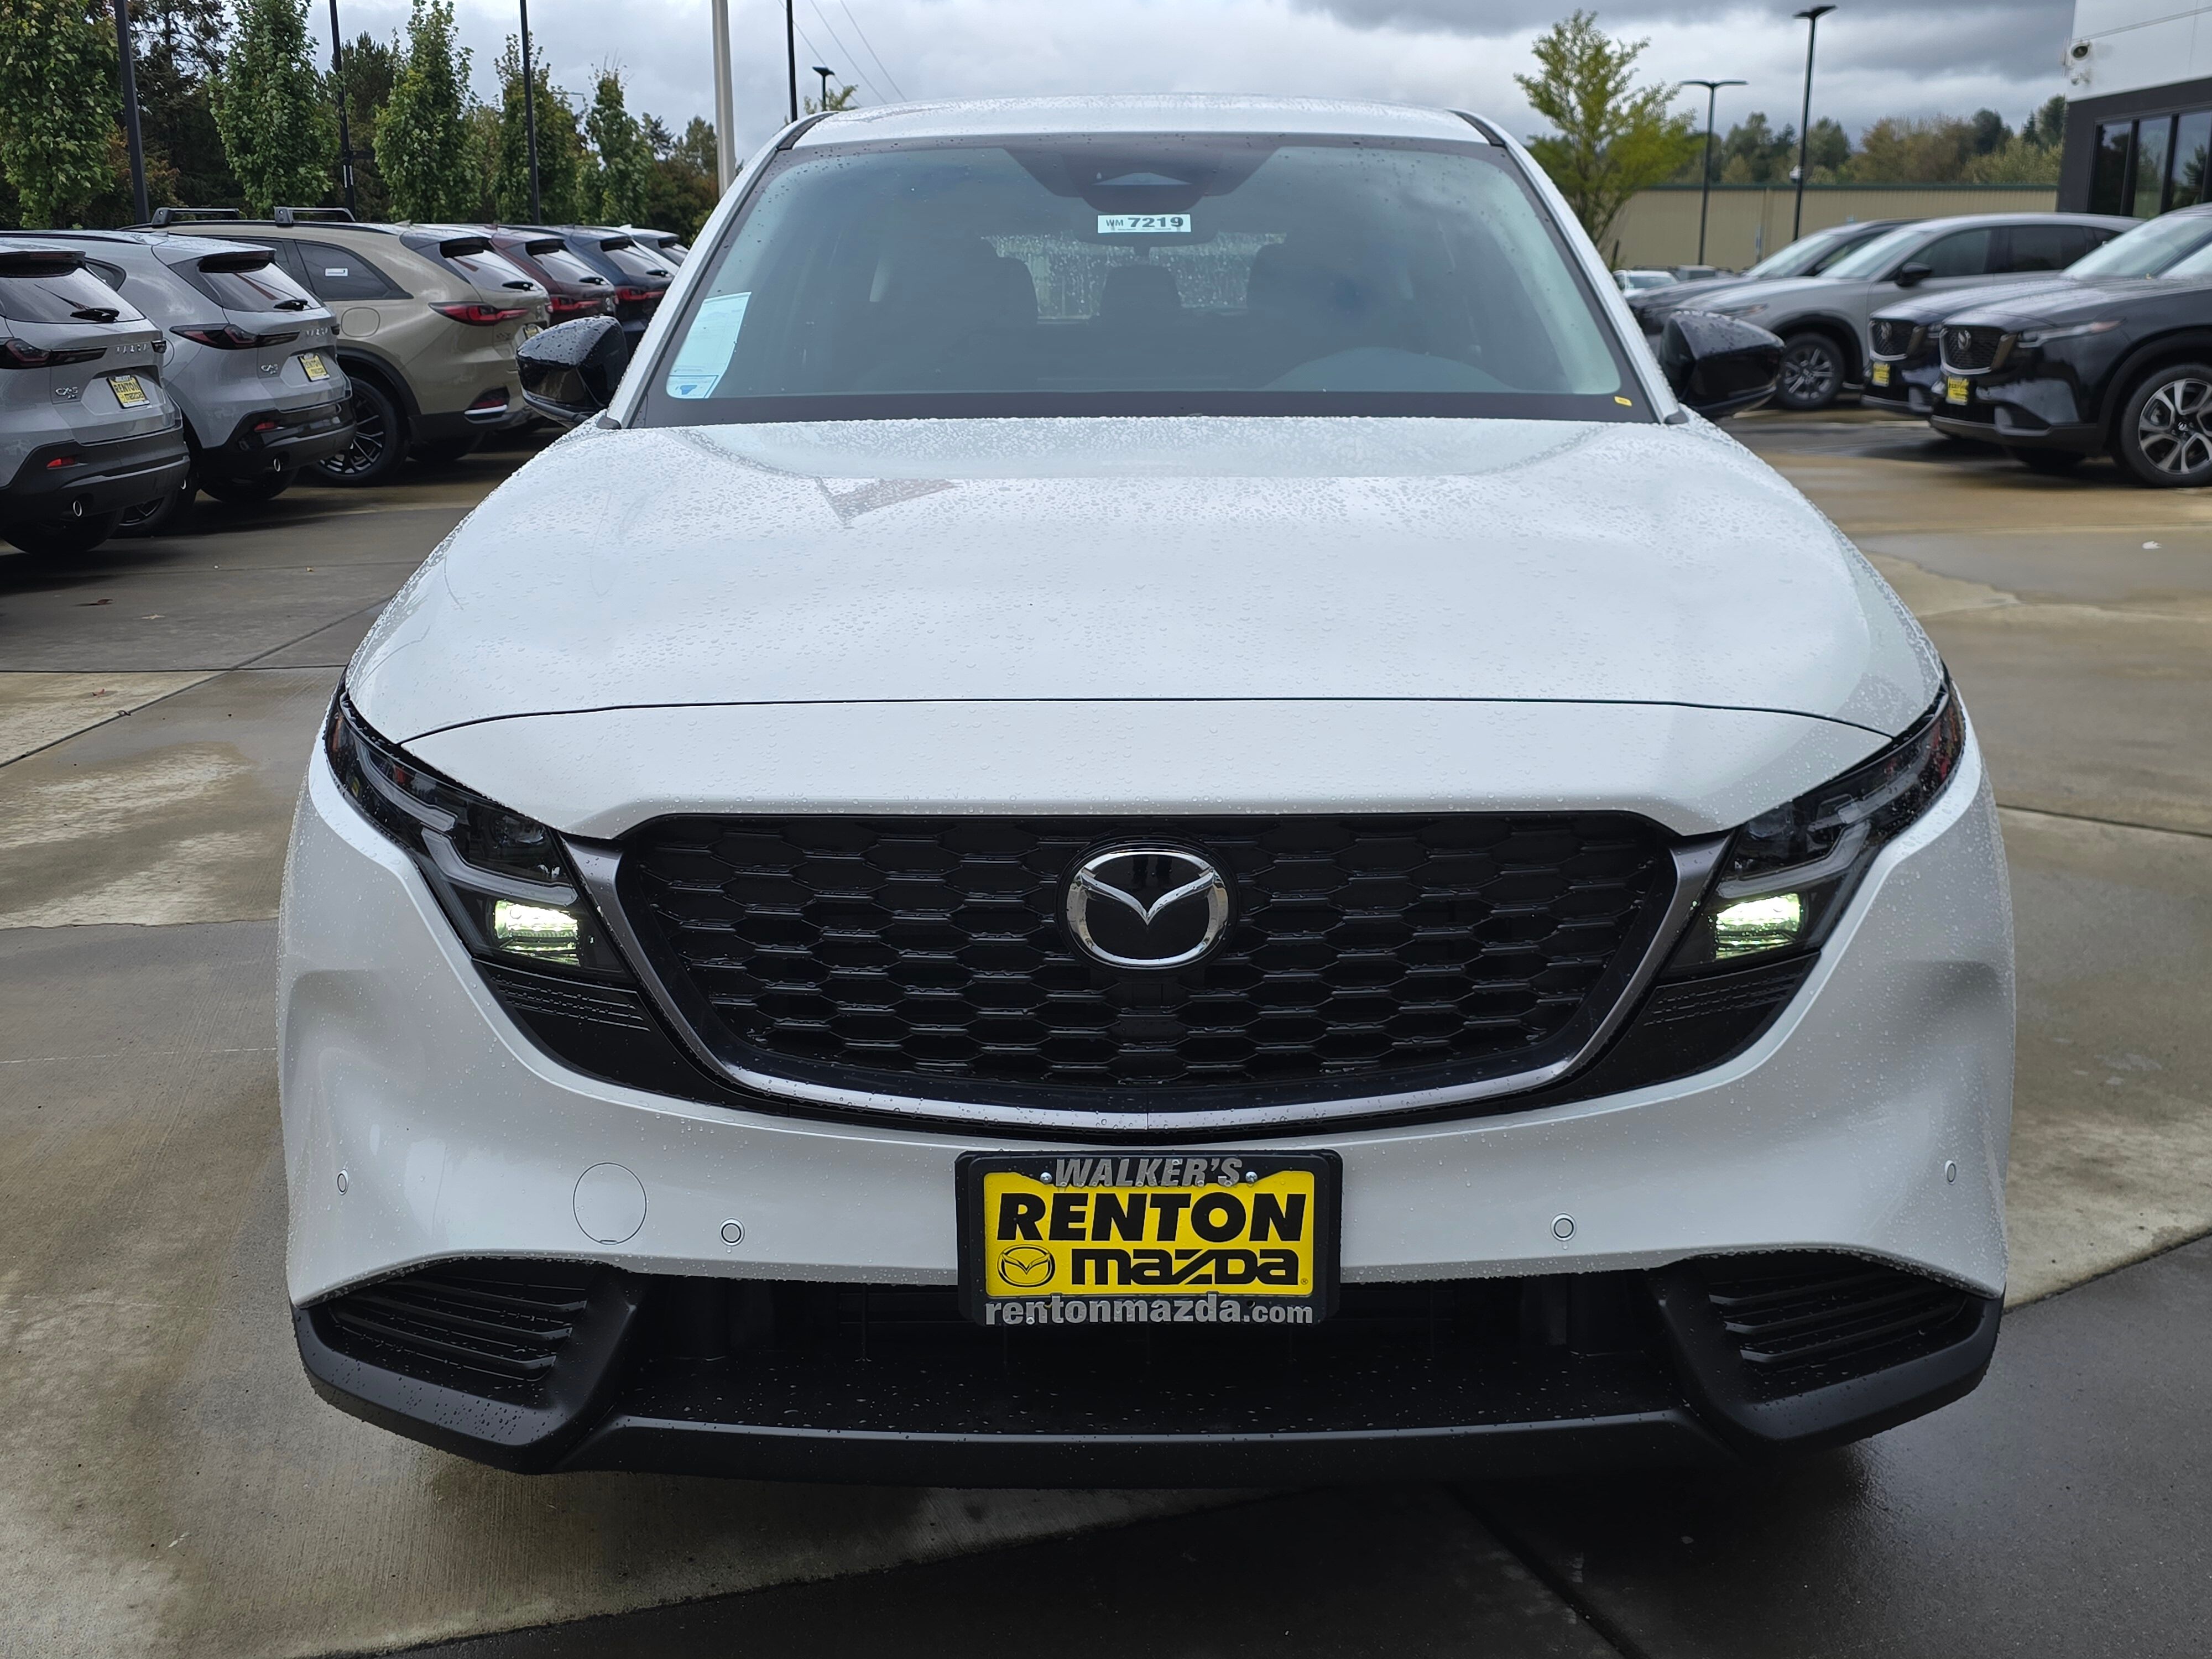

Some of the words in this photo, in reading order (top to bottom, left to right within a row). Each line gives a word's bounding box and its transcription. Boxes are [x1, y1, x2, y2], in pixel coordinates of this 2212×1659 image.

[1128, 217, 1183, 227] 7219
[113, 382, 140, 393] RENTON
[1055, 1158, 1243, 1187] WALKER'S
[997, 1192, 1307, 1243] RENTON
[985, 1294, 1313, 1324] rentonmazda.com
